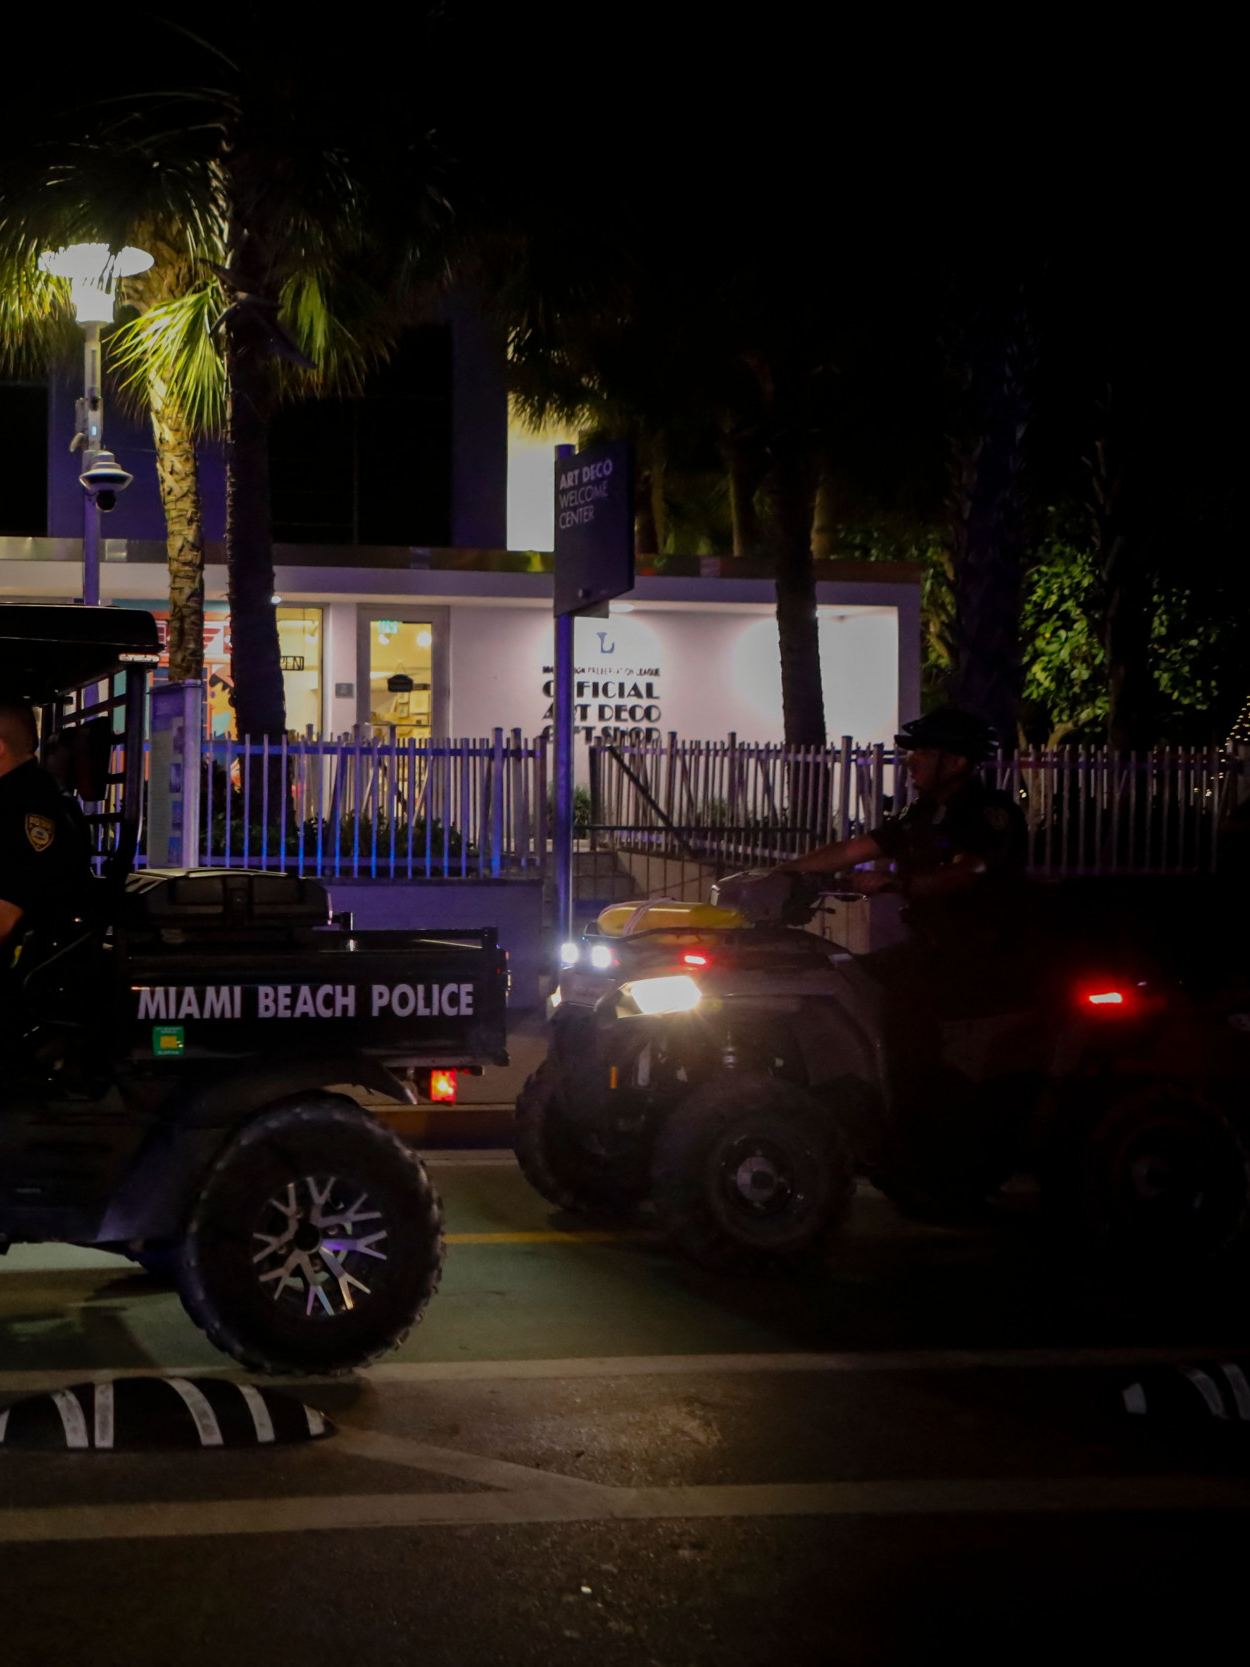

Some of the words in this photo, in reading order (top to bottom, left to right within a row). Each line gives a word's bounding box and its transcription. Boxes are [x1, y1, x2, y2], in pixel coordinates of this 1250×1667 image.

[559, 468, 581, 490] ART
[582, 458, 614, 483] DECO
[559, 480, 609, 509] WELCOME
[559, 505, 595, 529] CENTER
[279, 657, 302, 670] PEN
[542, 680, 660, 699] OFICIAL
[542, 703, 591, 721] AT
[598, 704, 661, 722] DECO
[542, 725, 595, 744] GT
[137, 986, 242, 1020] MIAMI
[257, 985, 355, 1018] BEACH
[371, 983, 474, 1017] POLICE
